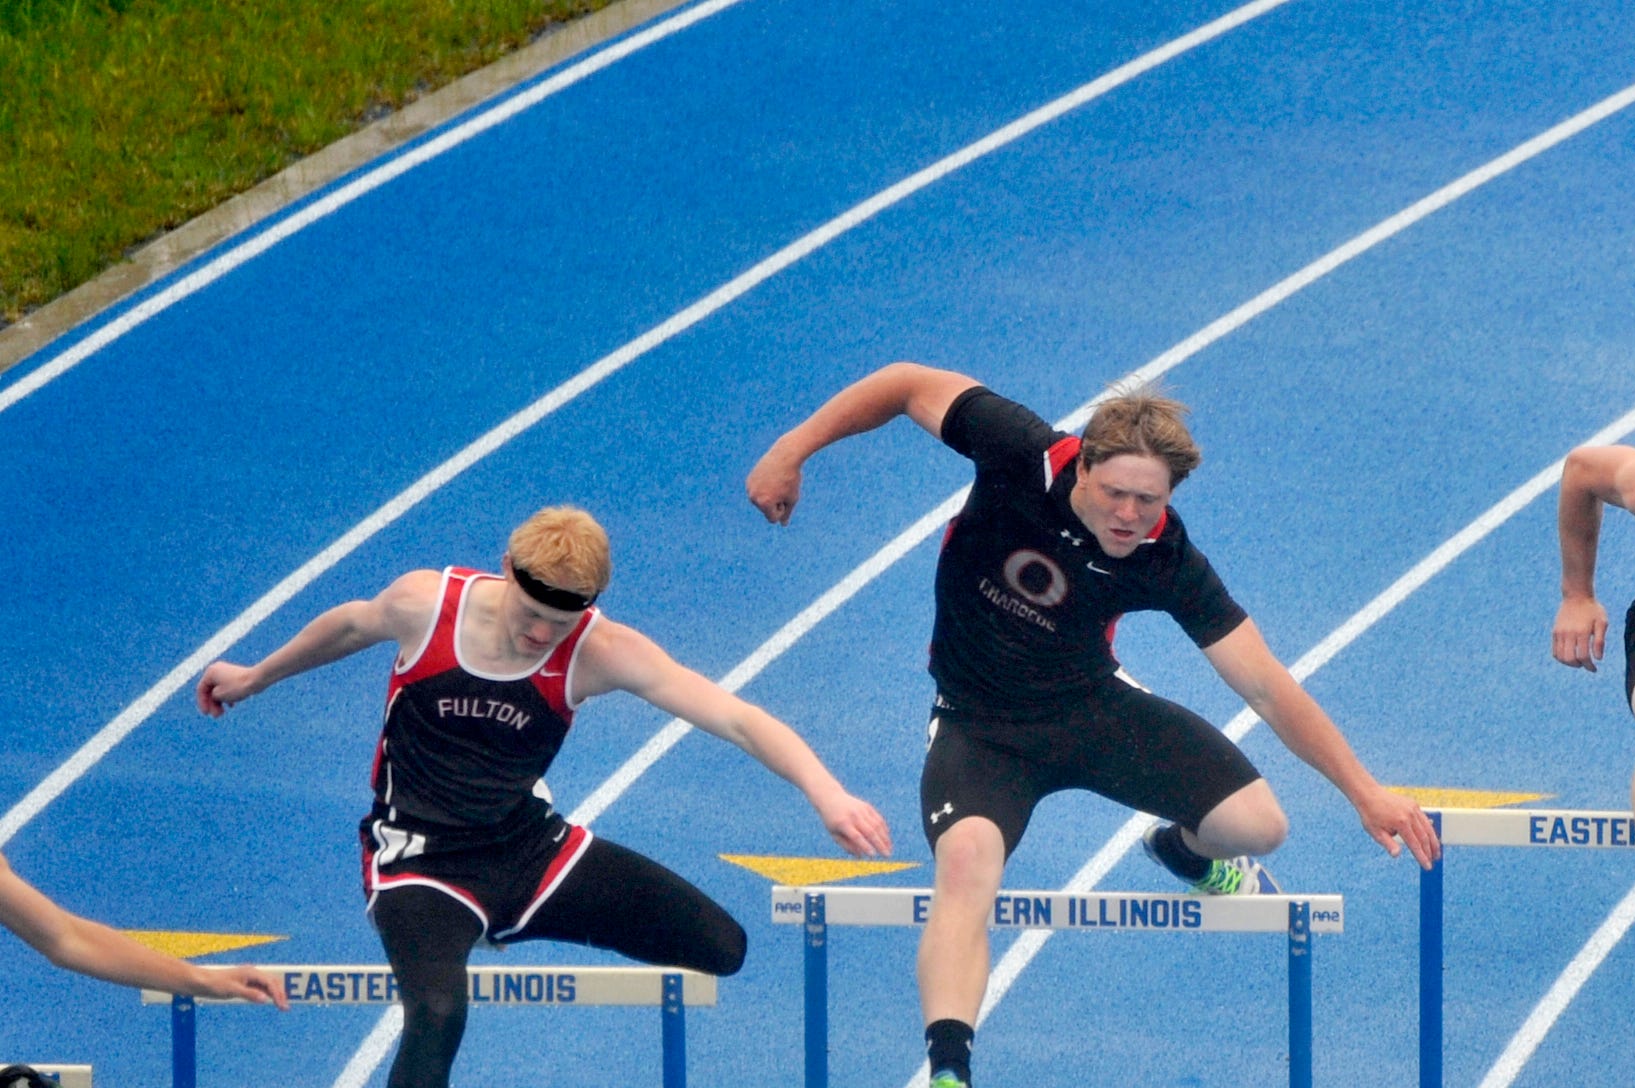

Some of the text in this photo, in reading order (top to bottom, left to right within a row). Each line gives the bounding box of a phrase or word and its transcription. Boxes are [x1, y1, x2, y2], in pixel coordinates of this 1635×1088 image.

[437, 697, 531, 731] FULTON
[912, 895, 1202, 928] EERN ILLINOIS
[284, 972, 577, 1003] EASTER LINOIS
